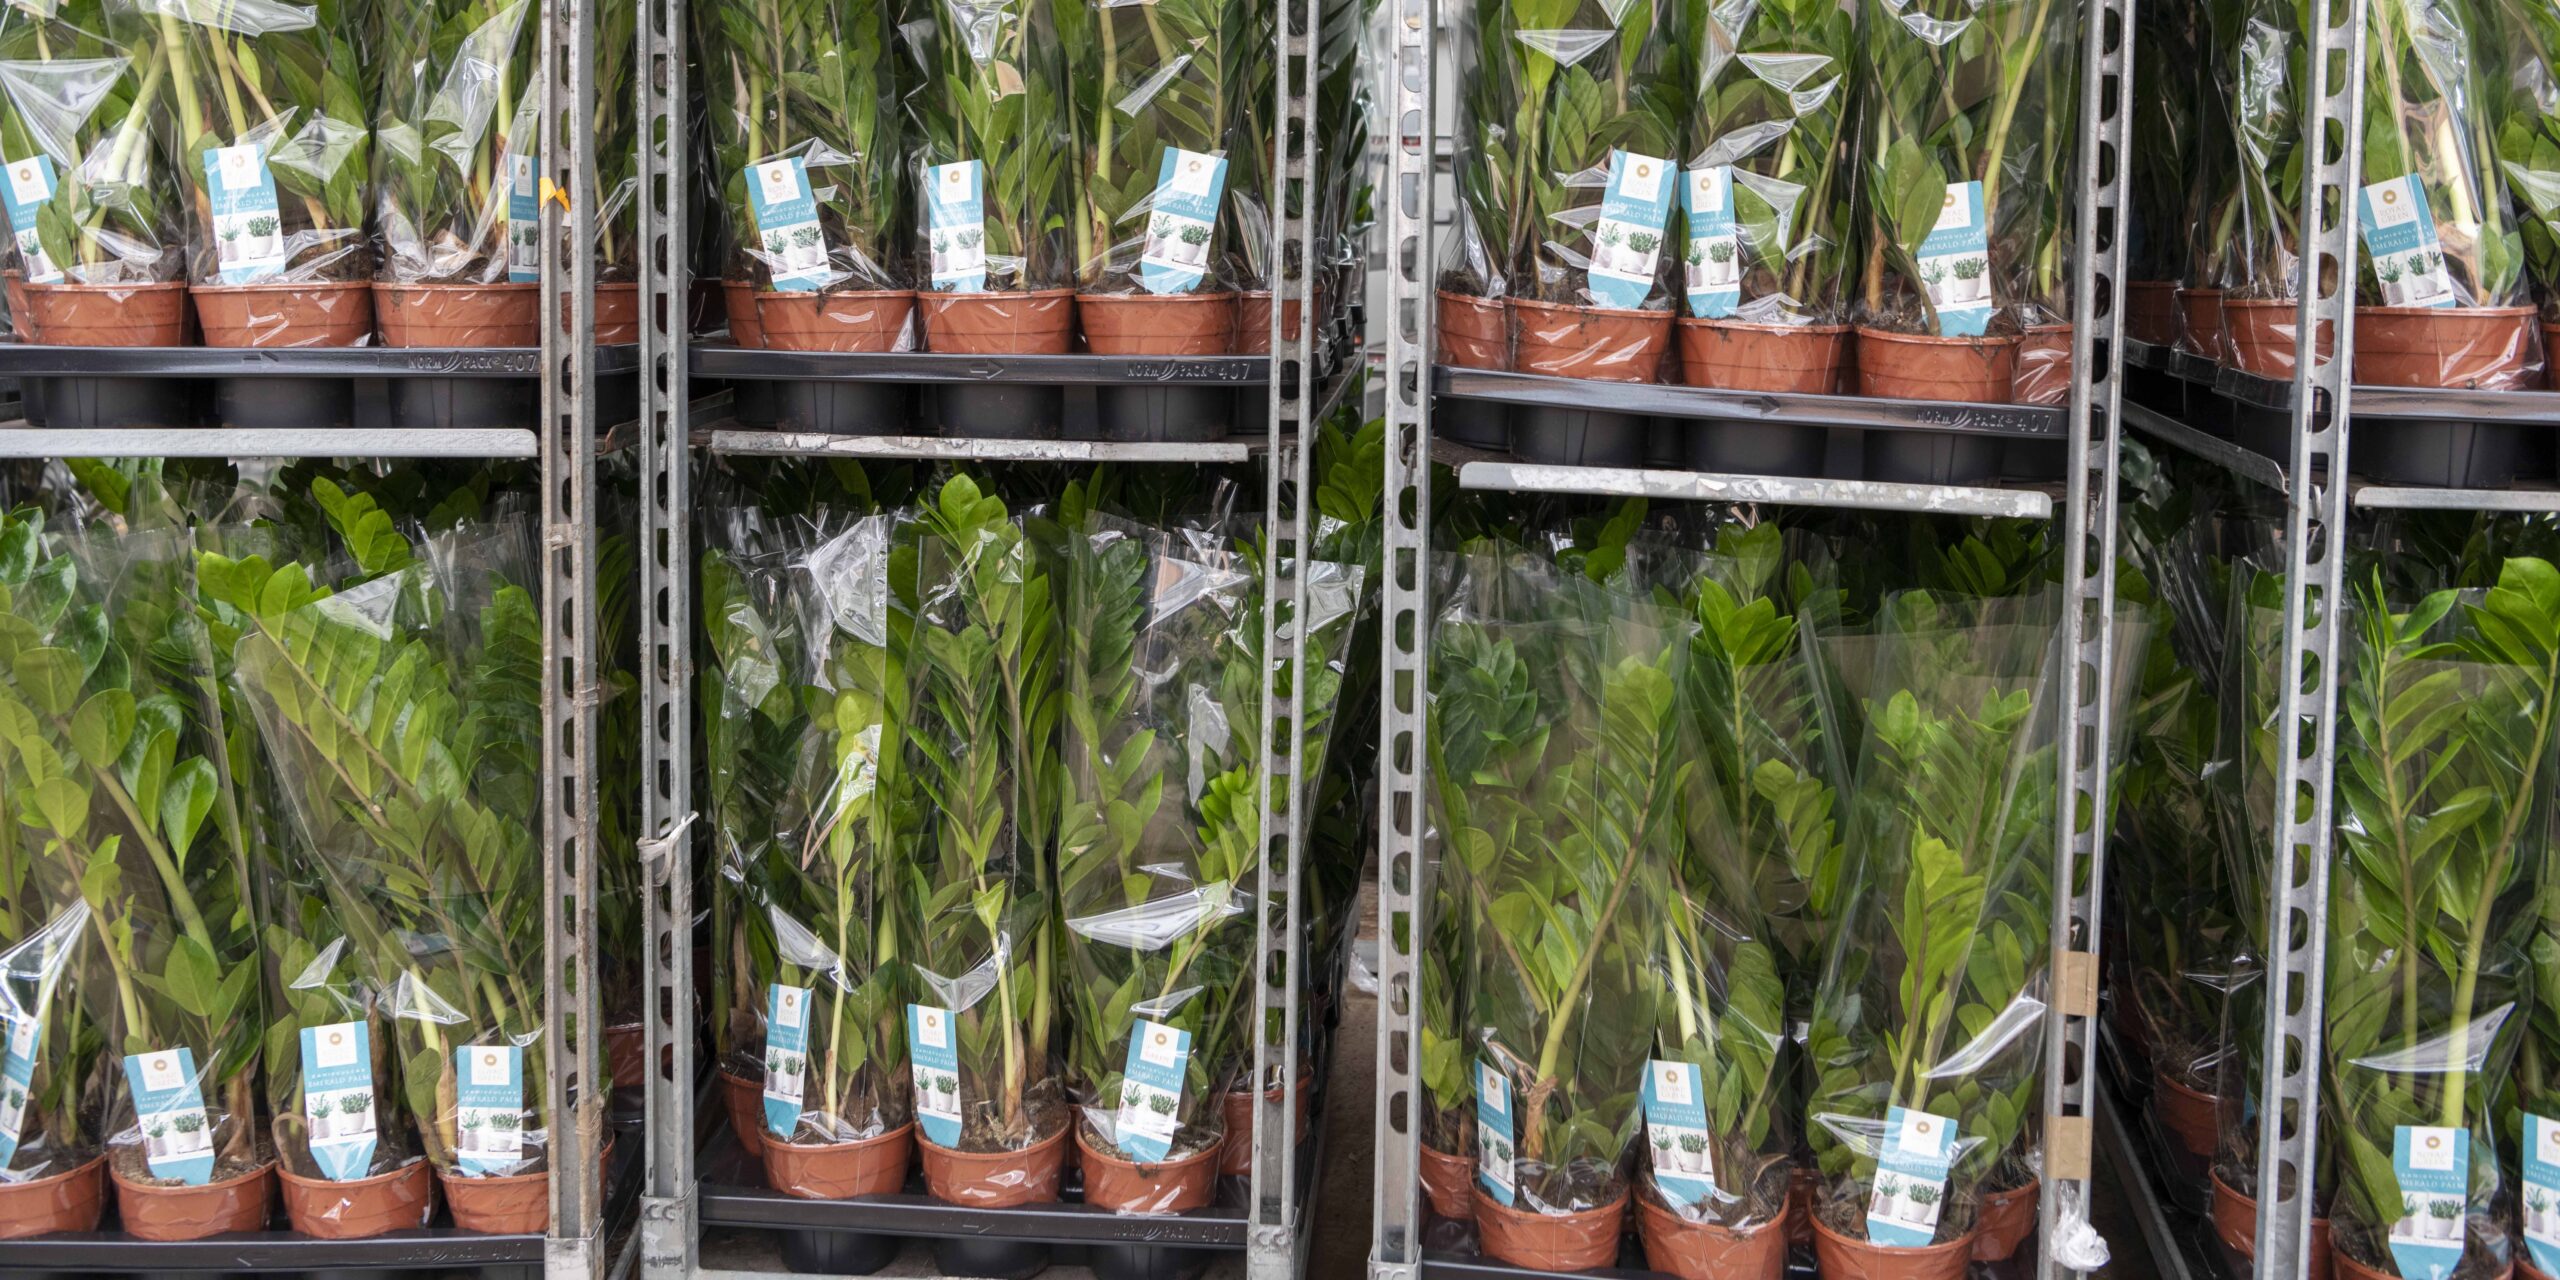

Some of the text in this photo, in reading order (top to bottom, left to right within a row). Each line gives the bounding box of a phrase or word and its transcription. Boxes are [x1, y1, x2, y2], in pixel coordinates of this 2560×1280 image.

[2379, 204, 2407, 217] ROYAL
[2381, 211, 2410, 224] GREEN
[760, 212, 794, 224] EMERALD
[1920, 237, 1985, 252] EMERALD PALM
[2371, 236, 2410, 251] EMERALD
[408, 354, 442, 369] NORM
[503, 354, 537, 371] 407
[1127, 363, 1159, 377] NORM
[1218, 363, 1251, 380] 407
[2017, 414, 2052, 432] 407
[913, 1053, 956, 1067] EMERALD PALM
[308, 1074, 370, 1088] EMERALD PALM
[1128, 1068, 1181, 1088] EMERALD PALM
[1649, 1112, 1704, 1124] EMERALD PALM
[2400, 1179, 2465, 1189] MERALD PALM
[1201, 1226, 1232, 1242] 407
